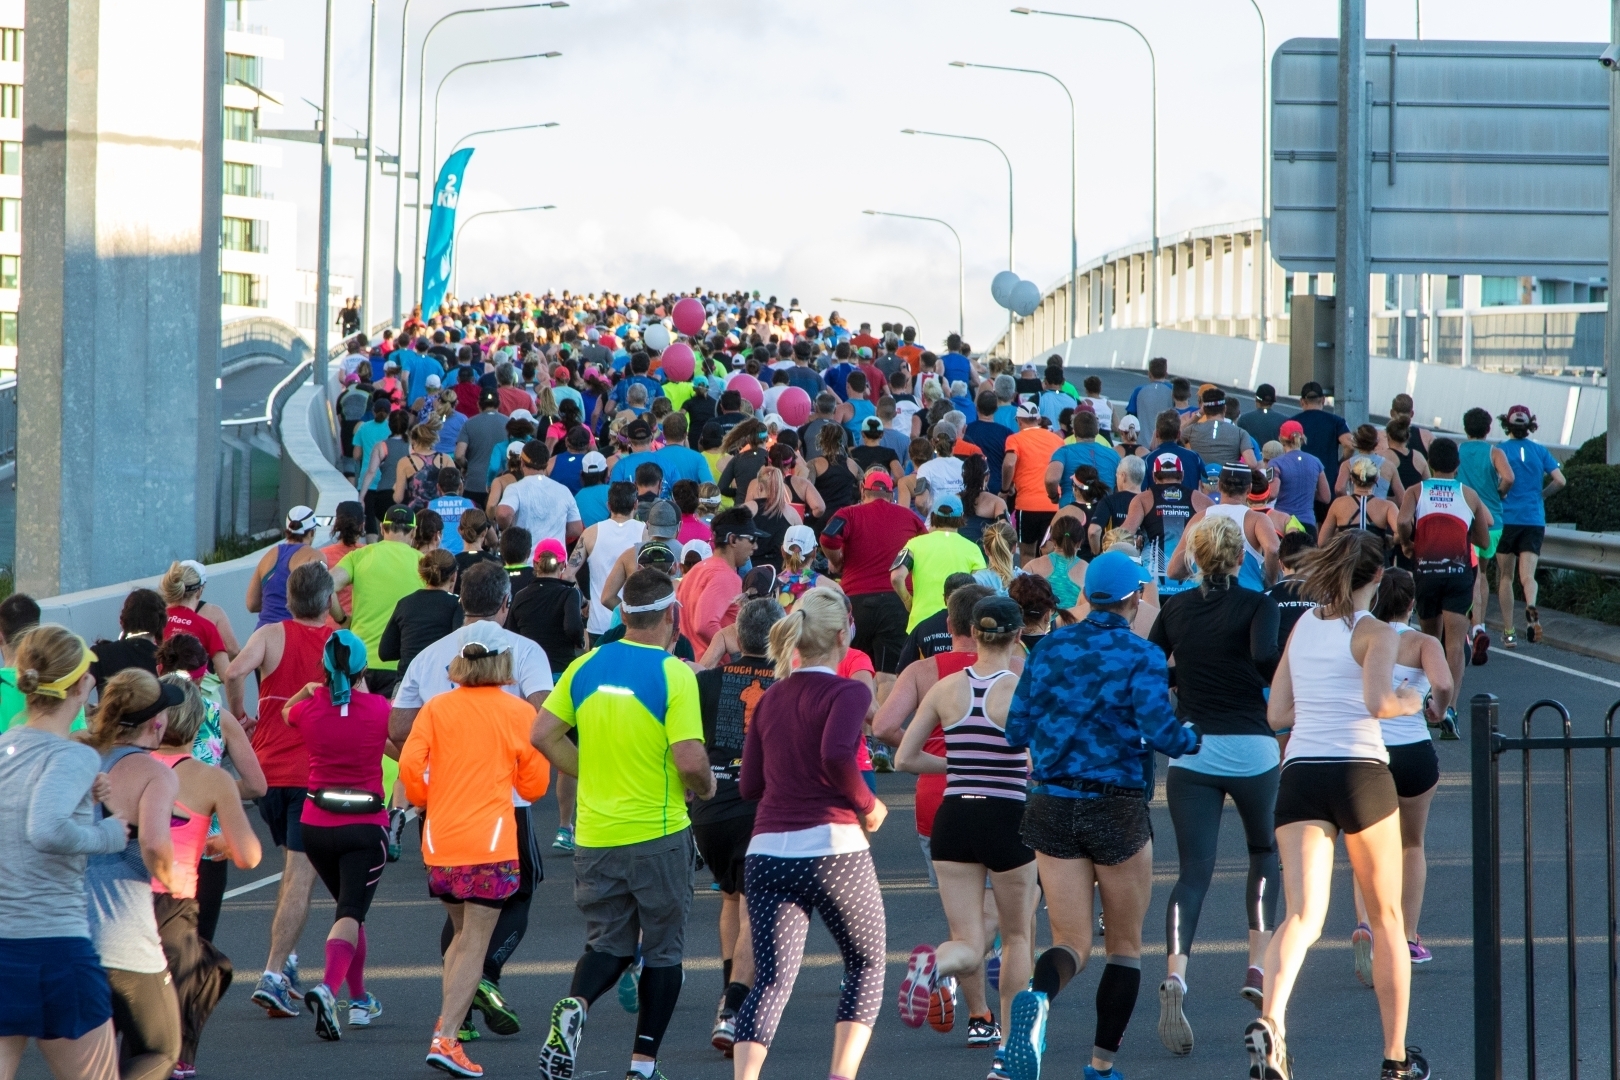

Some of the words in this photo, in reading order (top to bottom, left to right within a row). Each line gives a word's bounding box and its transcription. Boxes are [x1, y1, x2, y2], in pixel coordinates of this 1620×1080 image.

[445, 174, 457, 190] 2
[437, 190, 458, 209] KM
[1156, 509, 1190, 517] intraining
[723, 666, 752, 674] TOUGH
